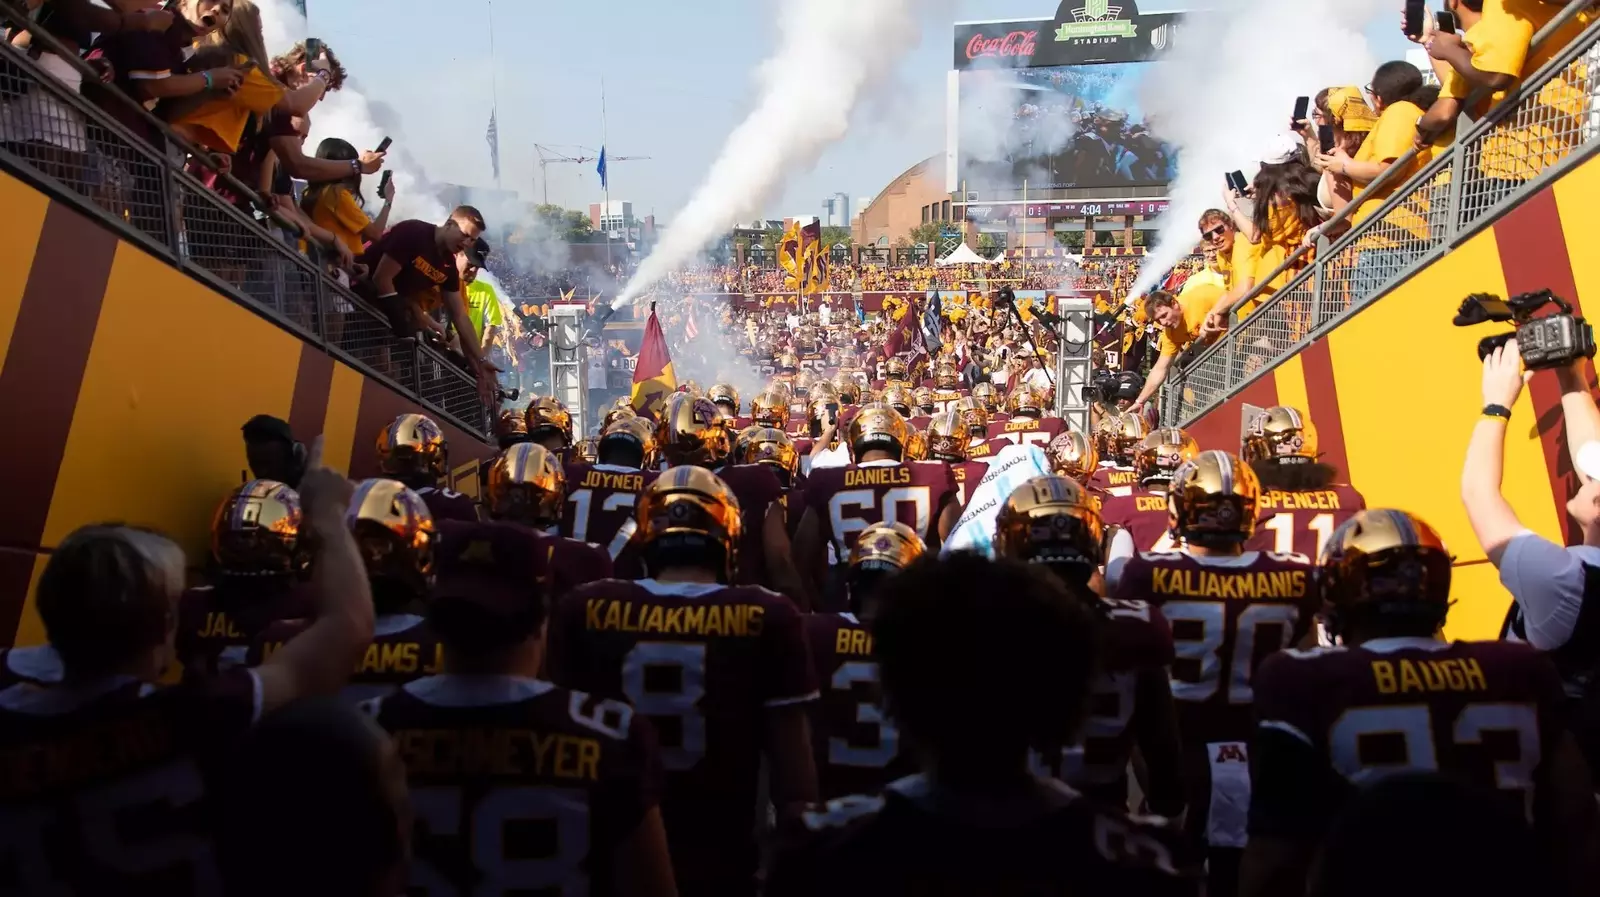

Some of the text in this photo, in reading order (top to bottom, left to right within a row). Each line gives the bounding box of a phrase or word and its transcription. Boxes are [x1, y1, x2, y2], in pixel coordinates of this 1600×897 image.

[1074, 37, 1117, 45] STADIUM
[1080, 204, 1101, 216] 4:04
[1004, 419, 1040, 432] COOPER
[580, 470, 644, 491] JOYNER
[844, 467, 911, 487] DANIELS
[1260, 490, 1340, 510] SPENCER
[1265, 512, 1335, 566] 11
[1152, 566, 1308, 599] KALIAKMANIS
[586, 599, 765, 638] KALIAKMANIS
[1370, 657, 1488, 694] BAUGH
[621, 640, 707, 772] 8
